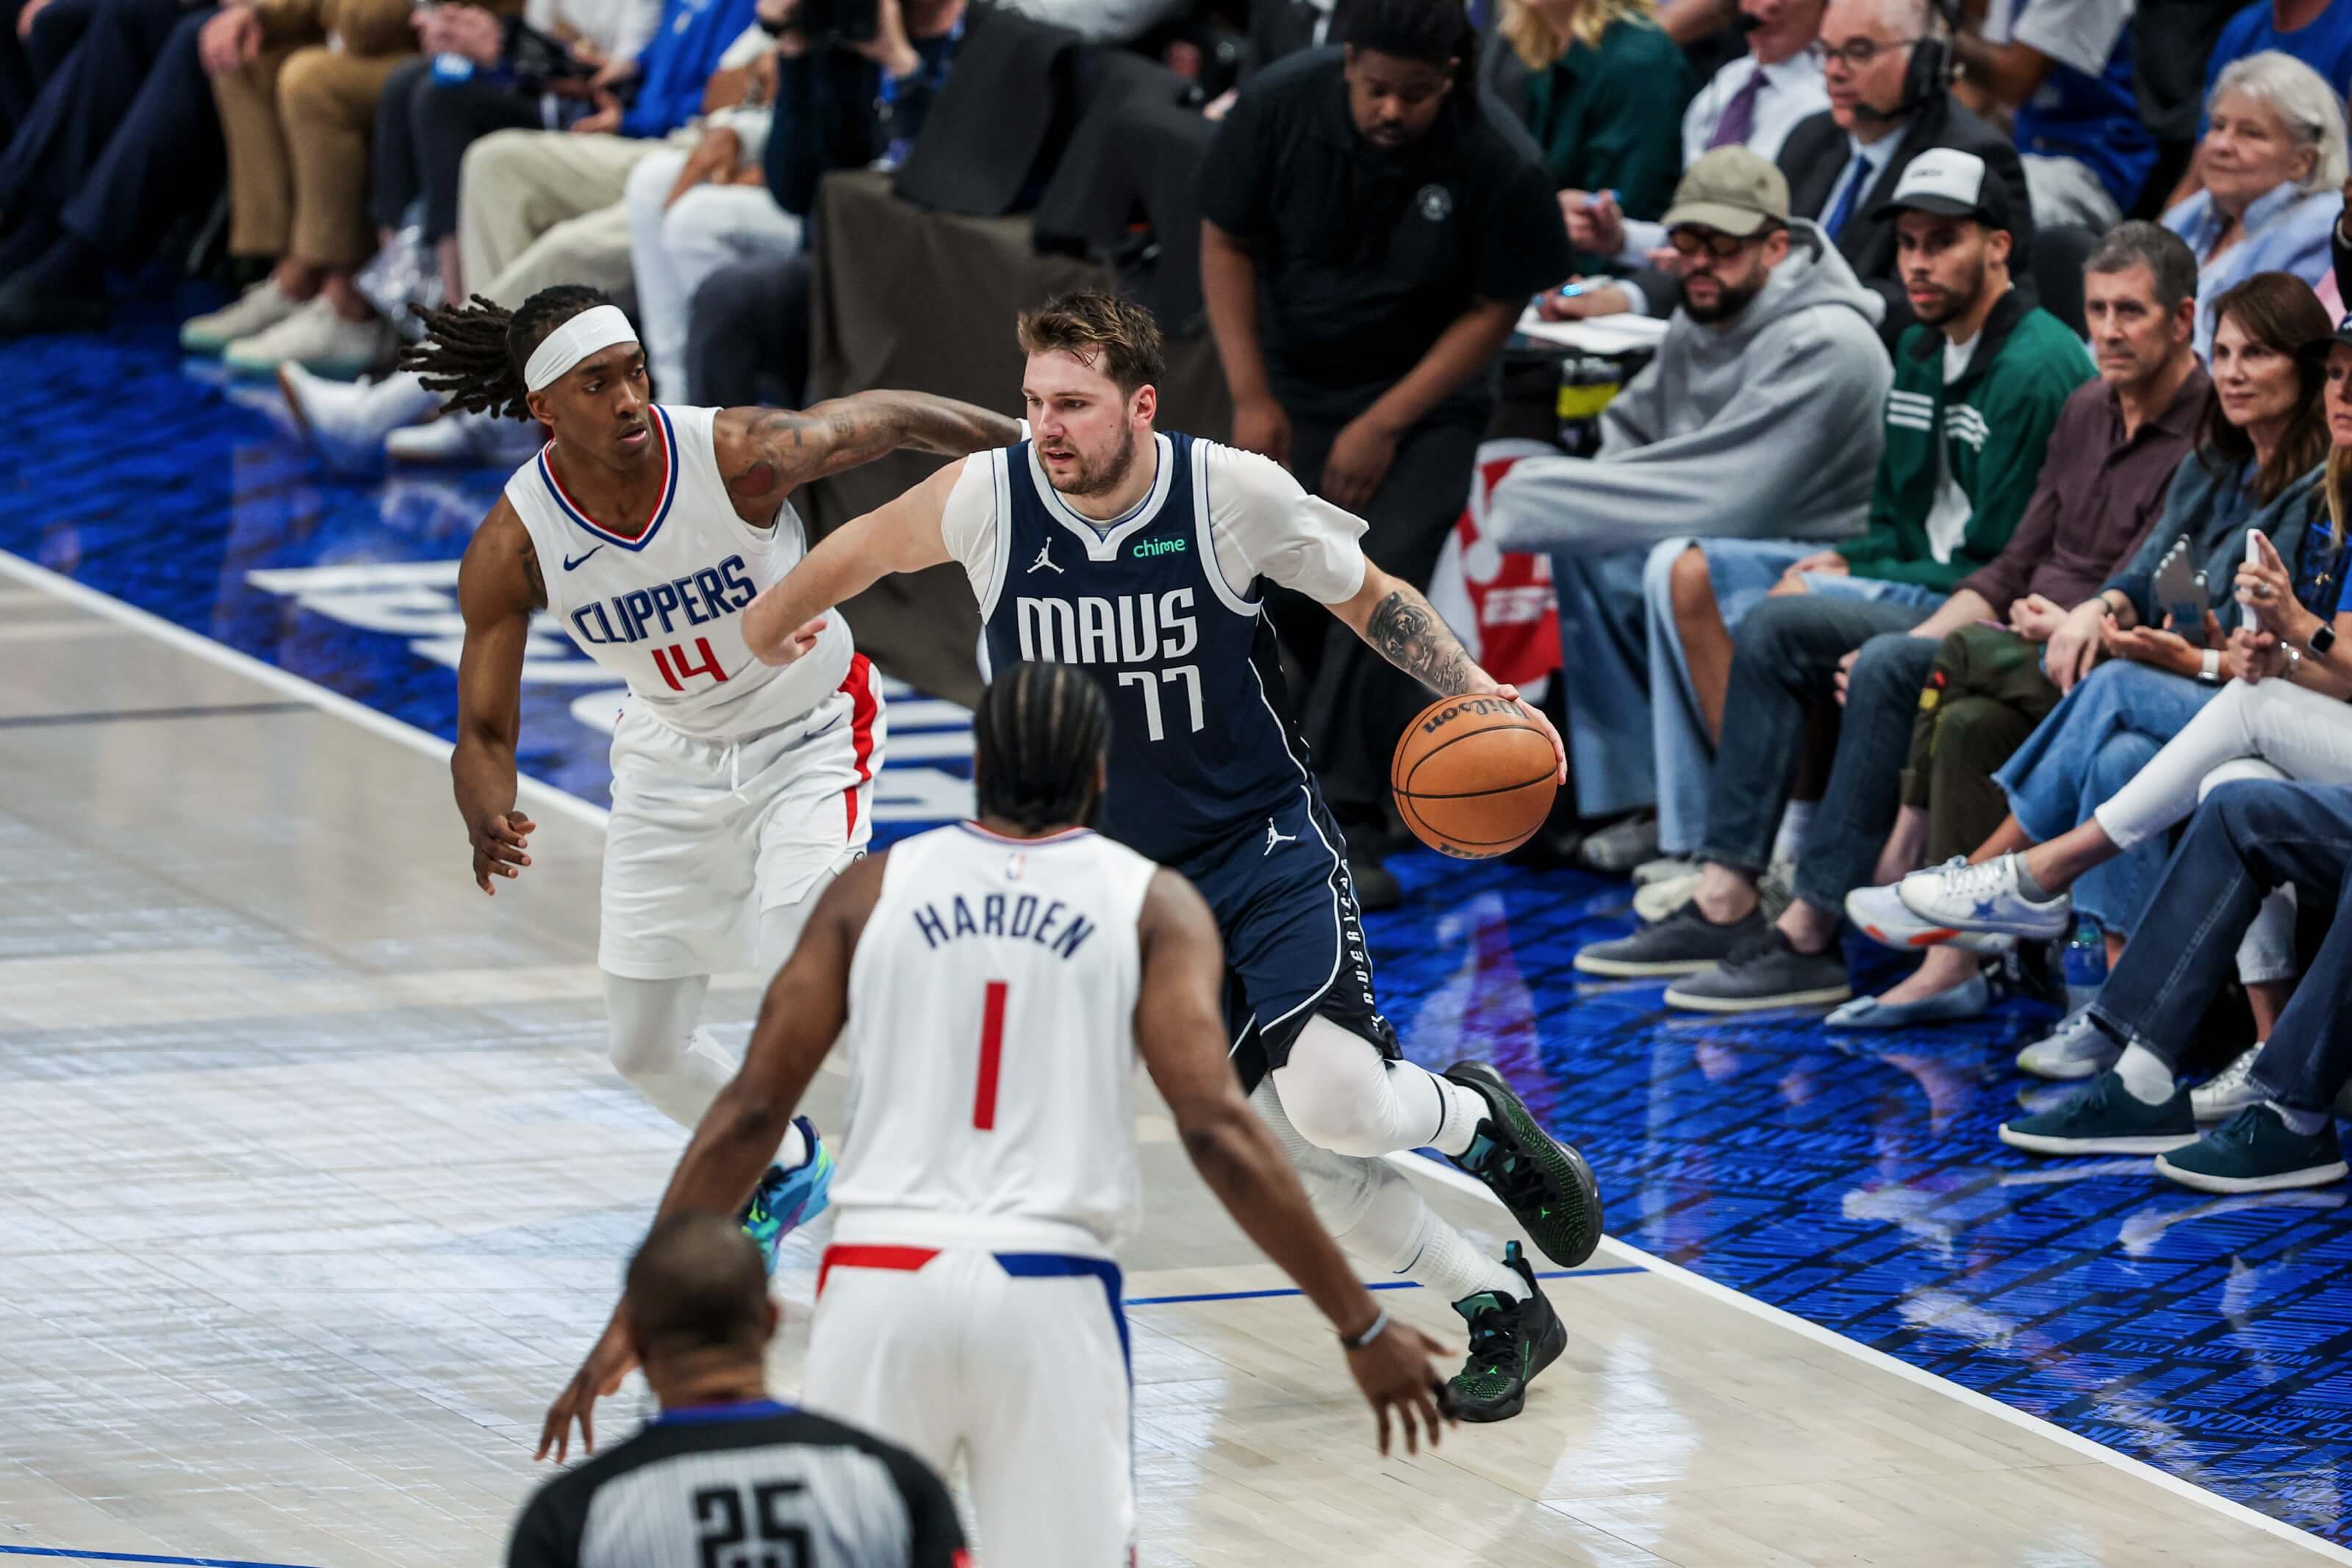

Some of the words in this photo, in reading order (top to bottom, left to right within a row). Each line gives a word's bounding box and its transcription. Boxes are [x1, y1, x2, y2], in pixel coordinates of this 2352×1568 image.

[1133, 537, 1186, 558] chime
[570, 554, 758, 644] CLIPPERS
[1017, 586, 1199, 664] MAVS
[651, 637, 729, 691] 14
[1117, 664, 1205, 741] 77
[1423, 699, 1531, 733] Wilson
[913, 893, 1096, 961] HARDEN
[972, 979, 1009, 1132] 1
[2171, 1345, 2241, 1359] VAN
[2243, 1349, 2323, 1367] NICK
[695, 1480, 812, 1568] 25
